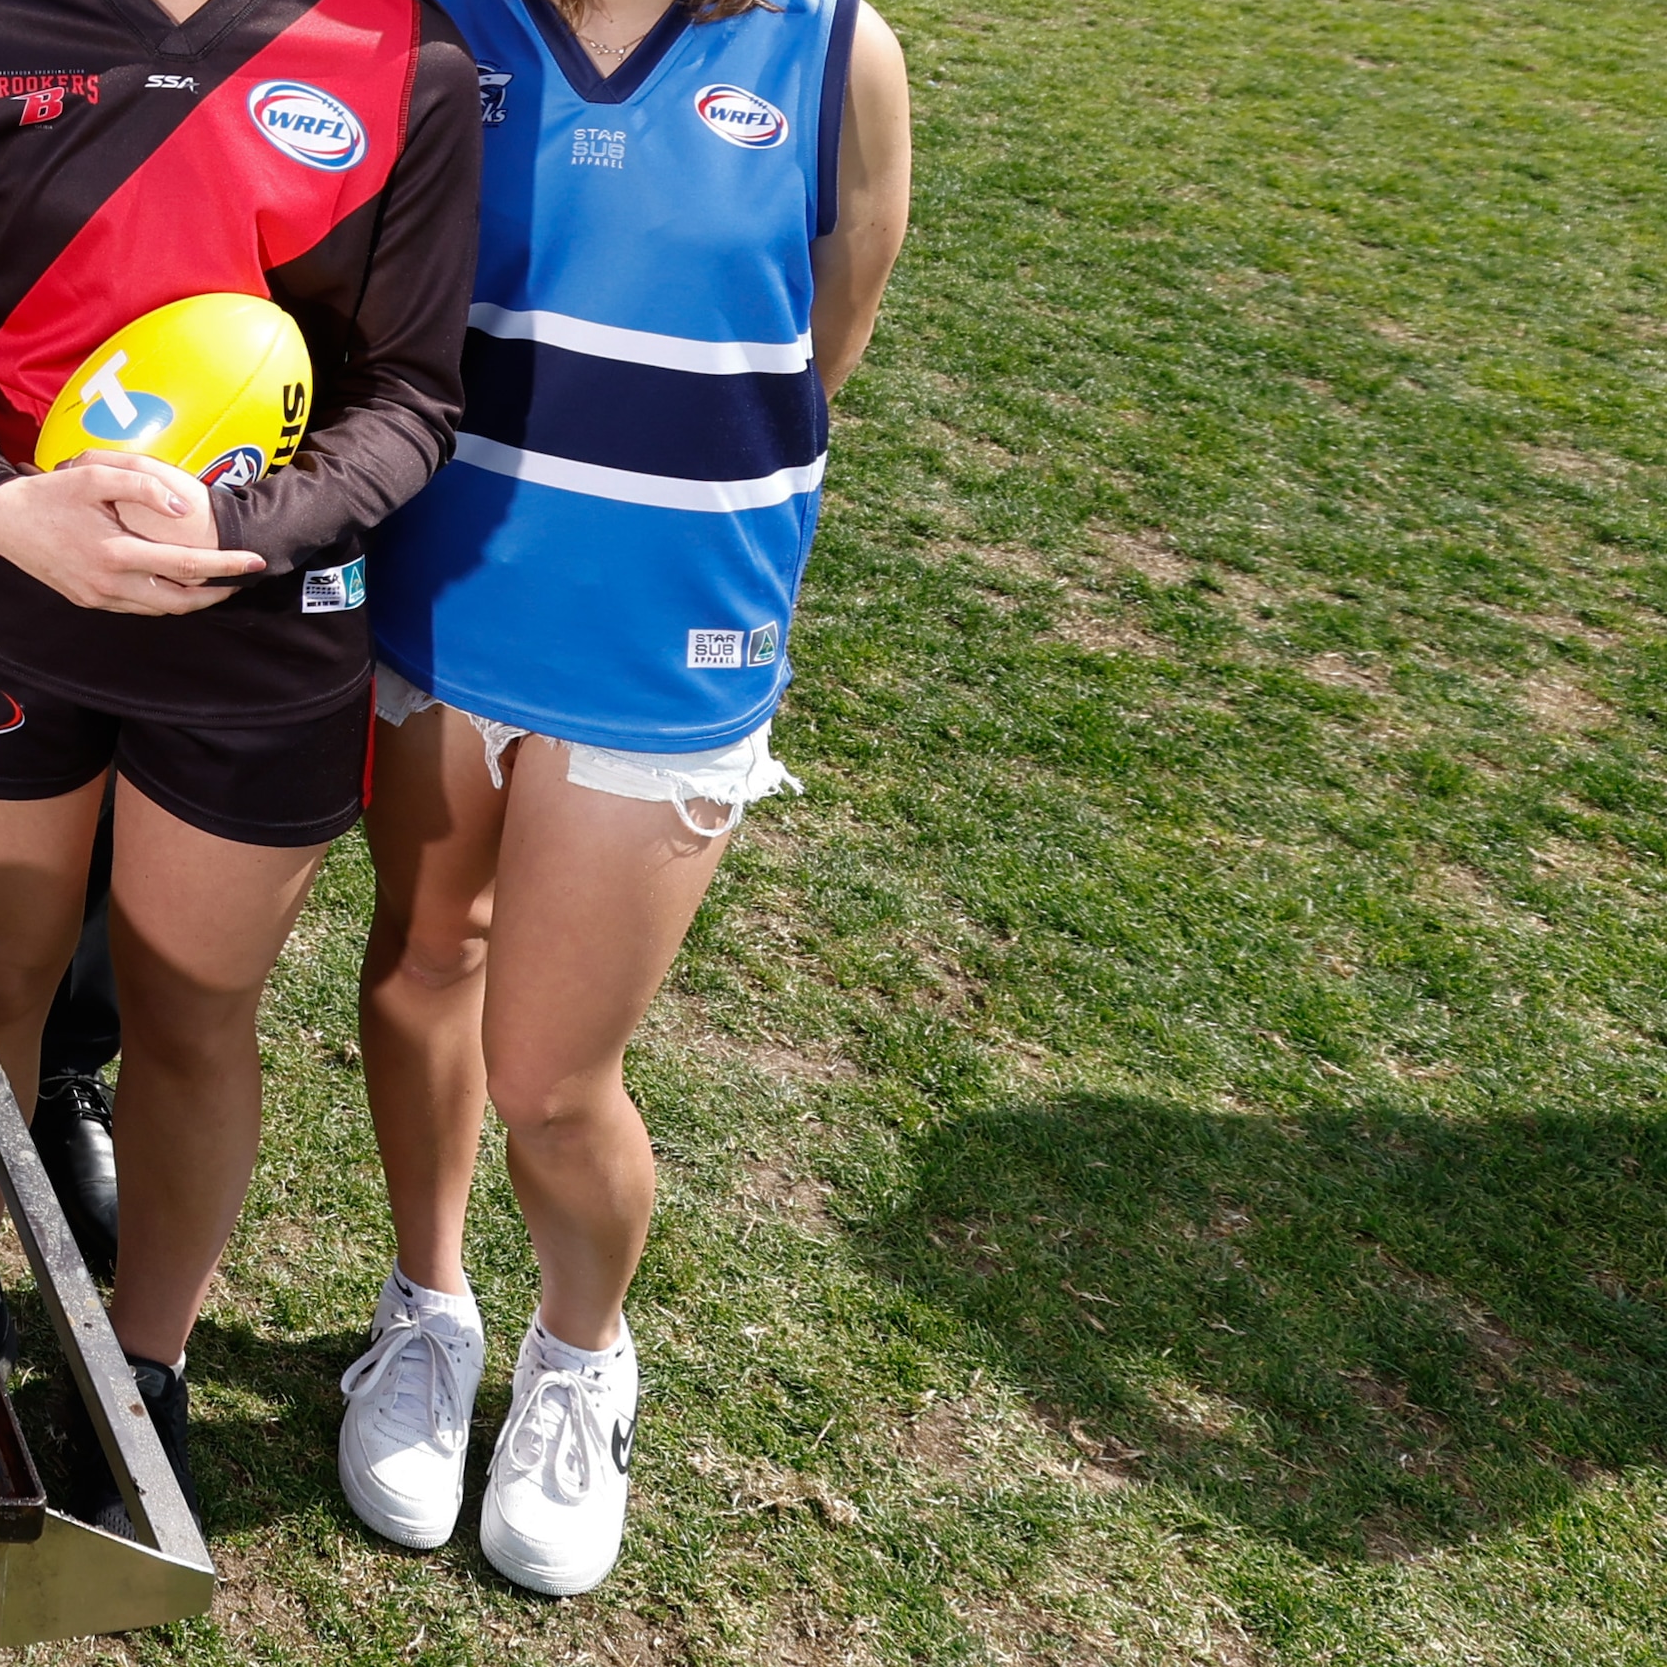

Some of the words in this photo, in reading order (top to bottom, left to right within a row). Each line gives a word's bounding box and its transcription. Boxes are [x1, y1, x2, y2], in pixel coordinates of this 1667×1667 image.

[144, 74, 201, 92] SSA
[266, 108, 347, 140] WRFL
[709, 105, 772, 126] WRFL
[574, 128, 627, 144] STAR
[572, 141, 625, 159] SUB
[571, 156, 624, 169] APPAREL
[79, 349, 138, 430] T
[695, 633, 736, 643] STAR
[695, 644, 734, 656] SUB
[694, 656, 735, 664] APPAREL
